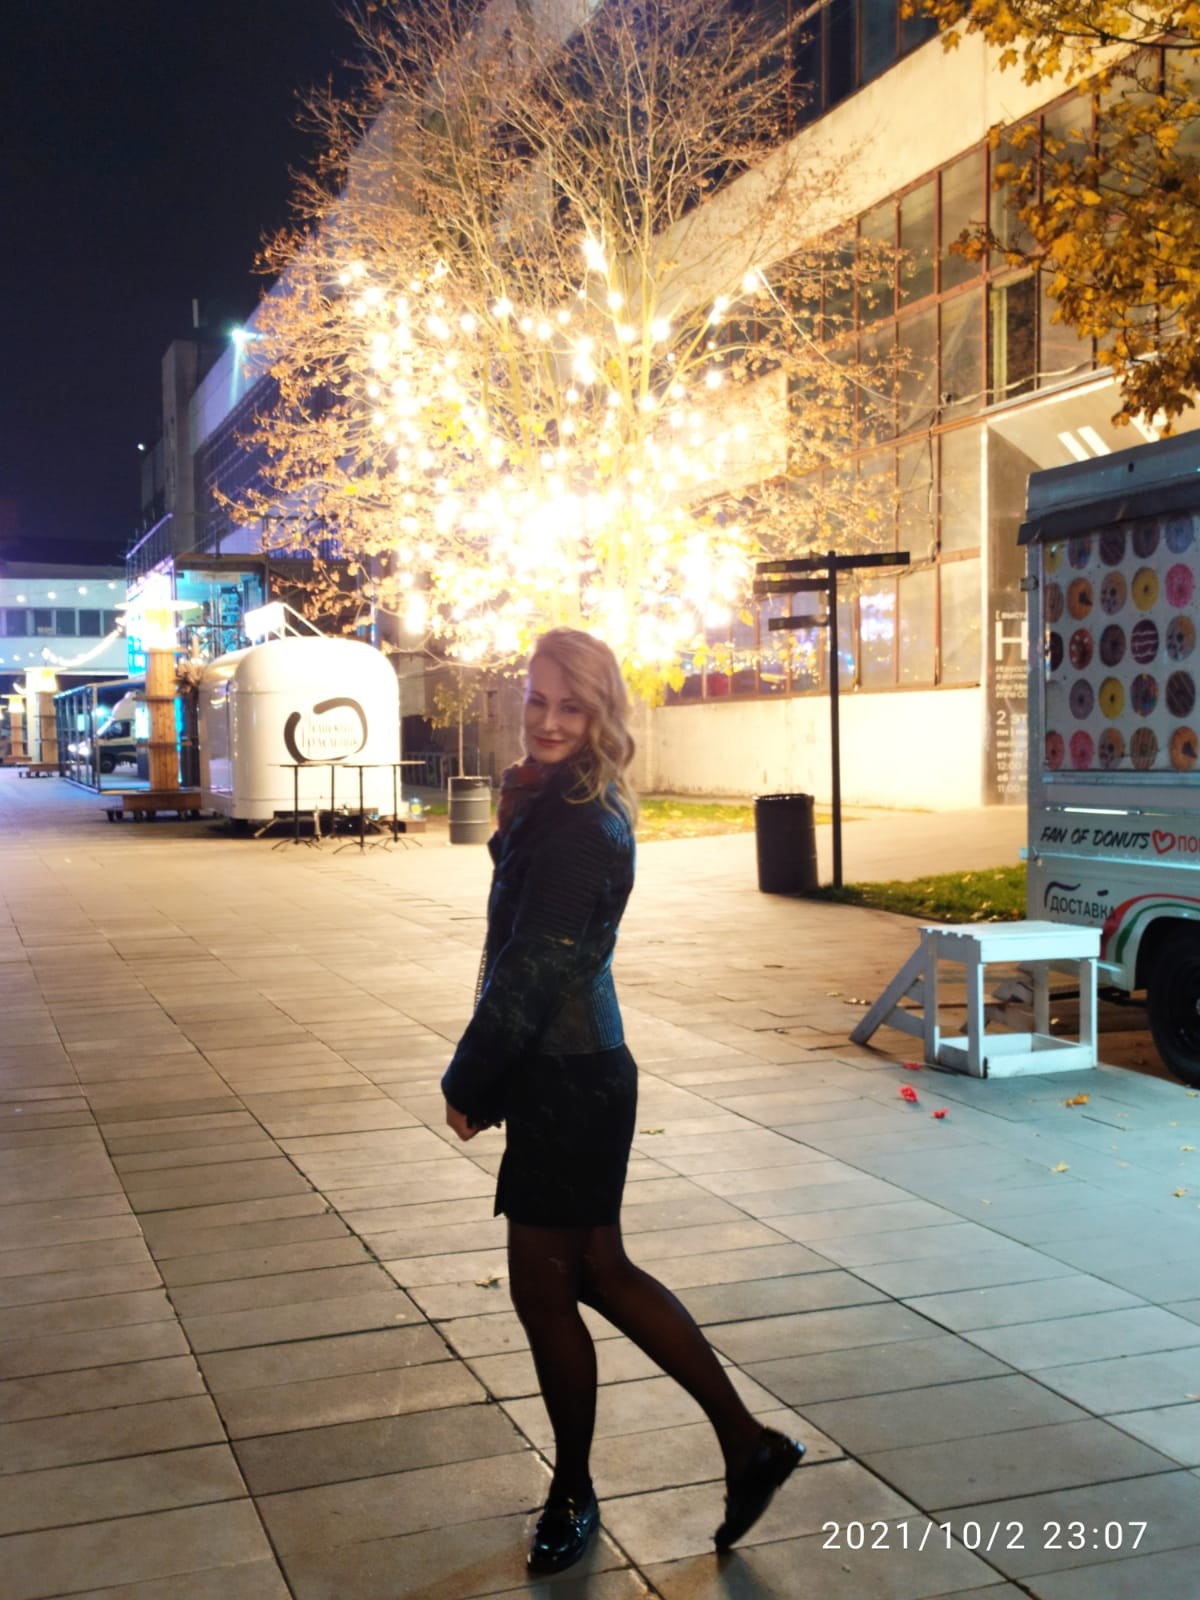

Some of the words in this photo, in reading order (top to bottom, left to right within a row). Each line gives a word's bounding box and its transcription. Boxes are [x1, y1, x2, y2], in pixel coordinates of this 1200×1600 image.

[996, 709, 1007, 725] 2
[1040, 826, 1068, 844] FAN
[1070, 828, 1090, 844] OF
[1092, 829, 1151, 850] DONUTS
[1177, 834, 1200, 853] ПО
[1050, 895, 1117, 921] ДОСТАВКА
